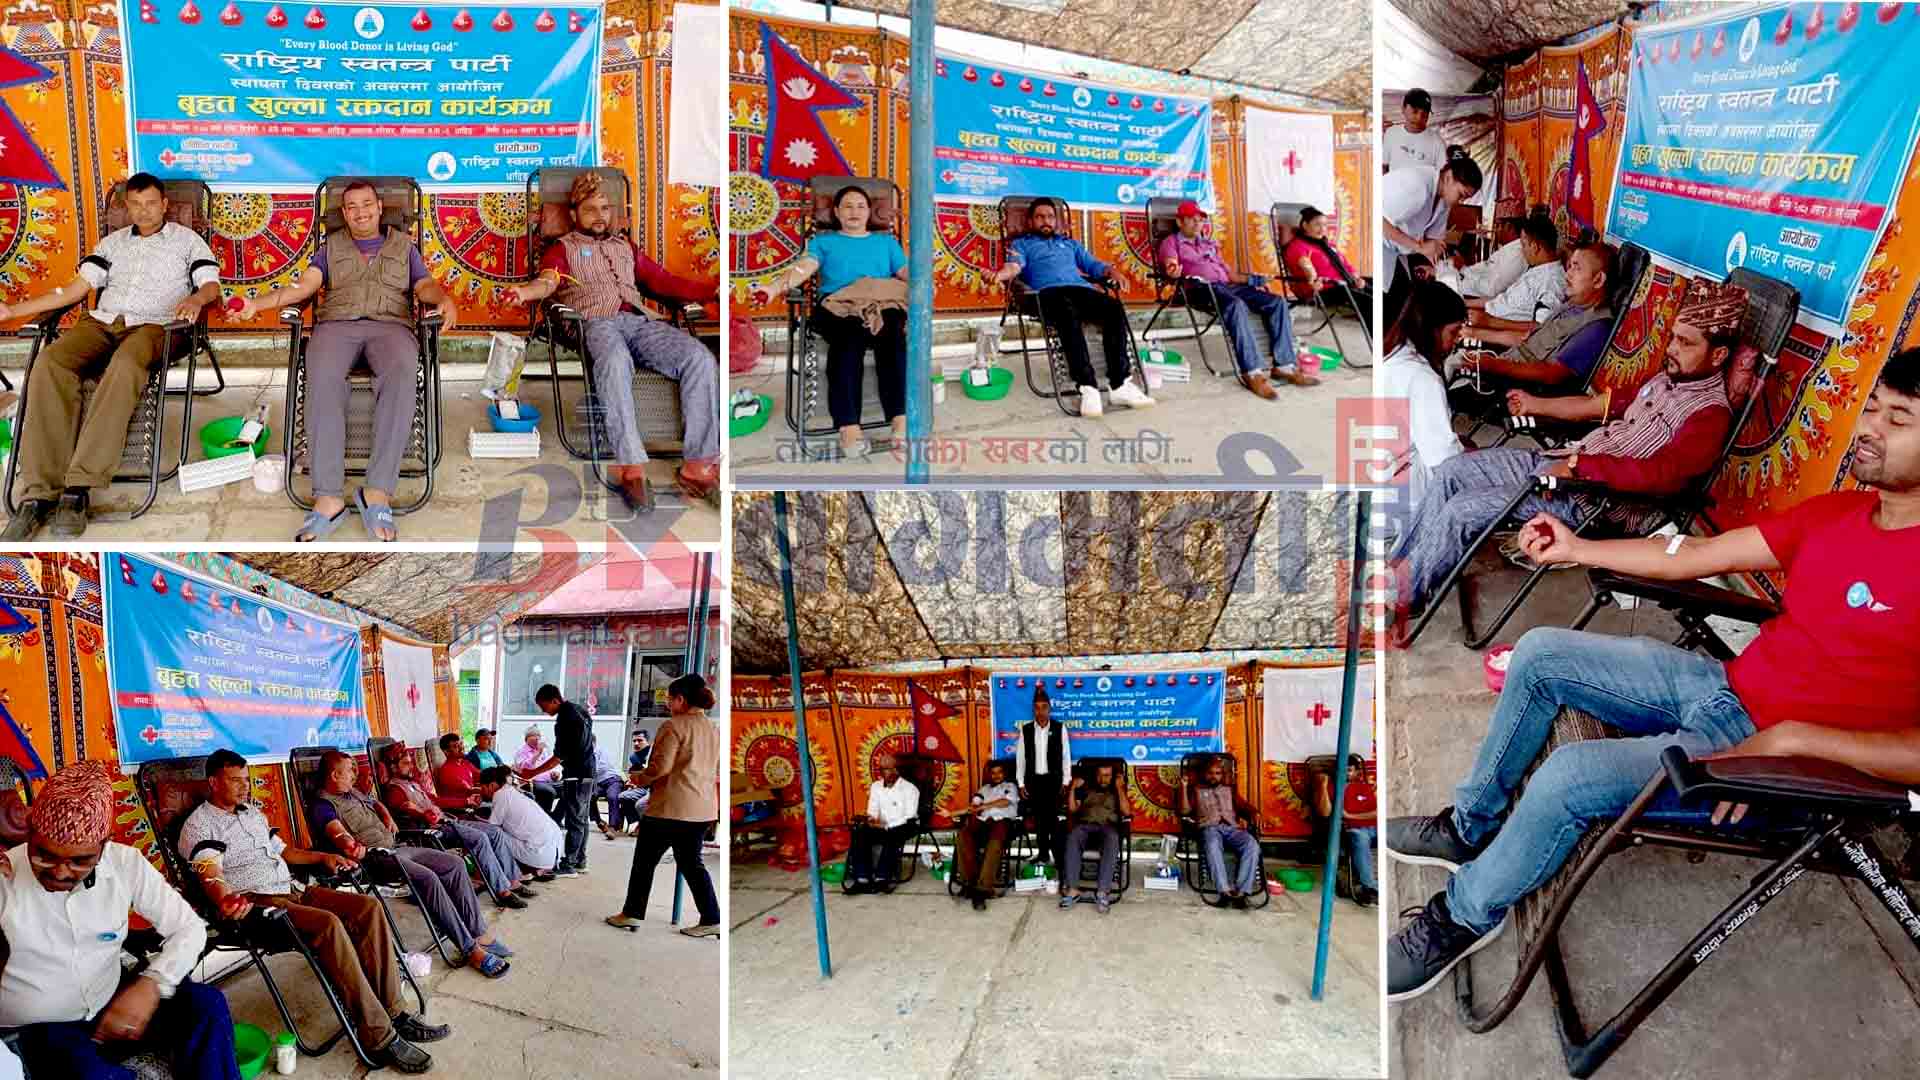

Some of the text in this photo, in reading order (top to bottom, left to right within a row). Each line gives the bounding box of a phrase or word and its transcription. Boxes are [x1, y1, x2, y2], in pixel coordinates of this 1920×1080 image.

[318, 39, 348, 50] Blood
[351, 40, 382, 50] Donor
[385, 42, 393, 51] is
[396, 42, 429, 53] Living
[220, 49, 512, 74] राष्ट्रिय स्वतन्त्र पार्टी
[230, 76, 504, 93] स्थापना दिवसको अवसरमा आयोजित
[1657, 88, 1713, 119] राष्ट्रिय
[1717, 87, 1779, 112] स्वतन्त्र
[1785, 73, 1840, 106] पार्टी
[177, 95, 553, 118] बृहत खुल्ला रक्तदान कार्यक्रम
[497, 142, 540, 153] आयोजक
[460, 155, 502, 170] राष्ट्रिय
[1760, 146, 1859, 185] कार्यक्रम
[1779, 229, 1820, 249] आयोजक
